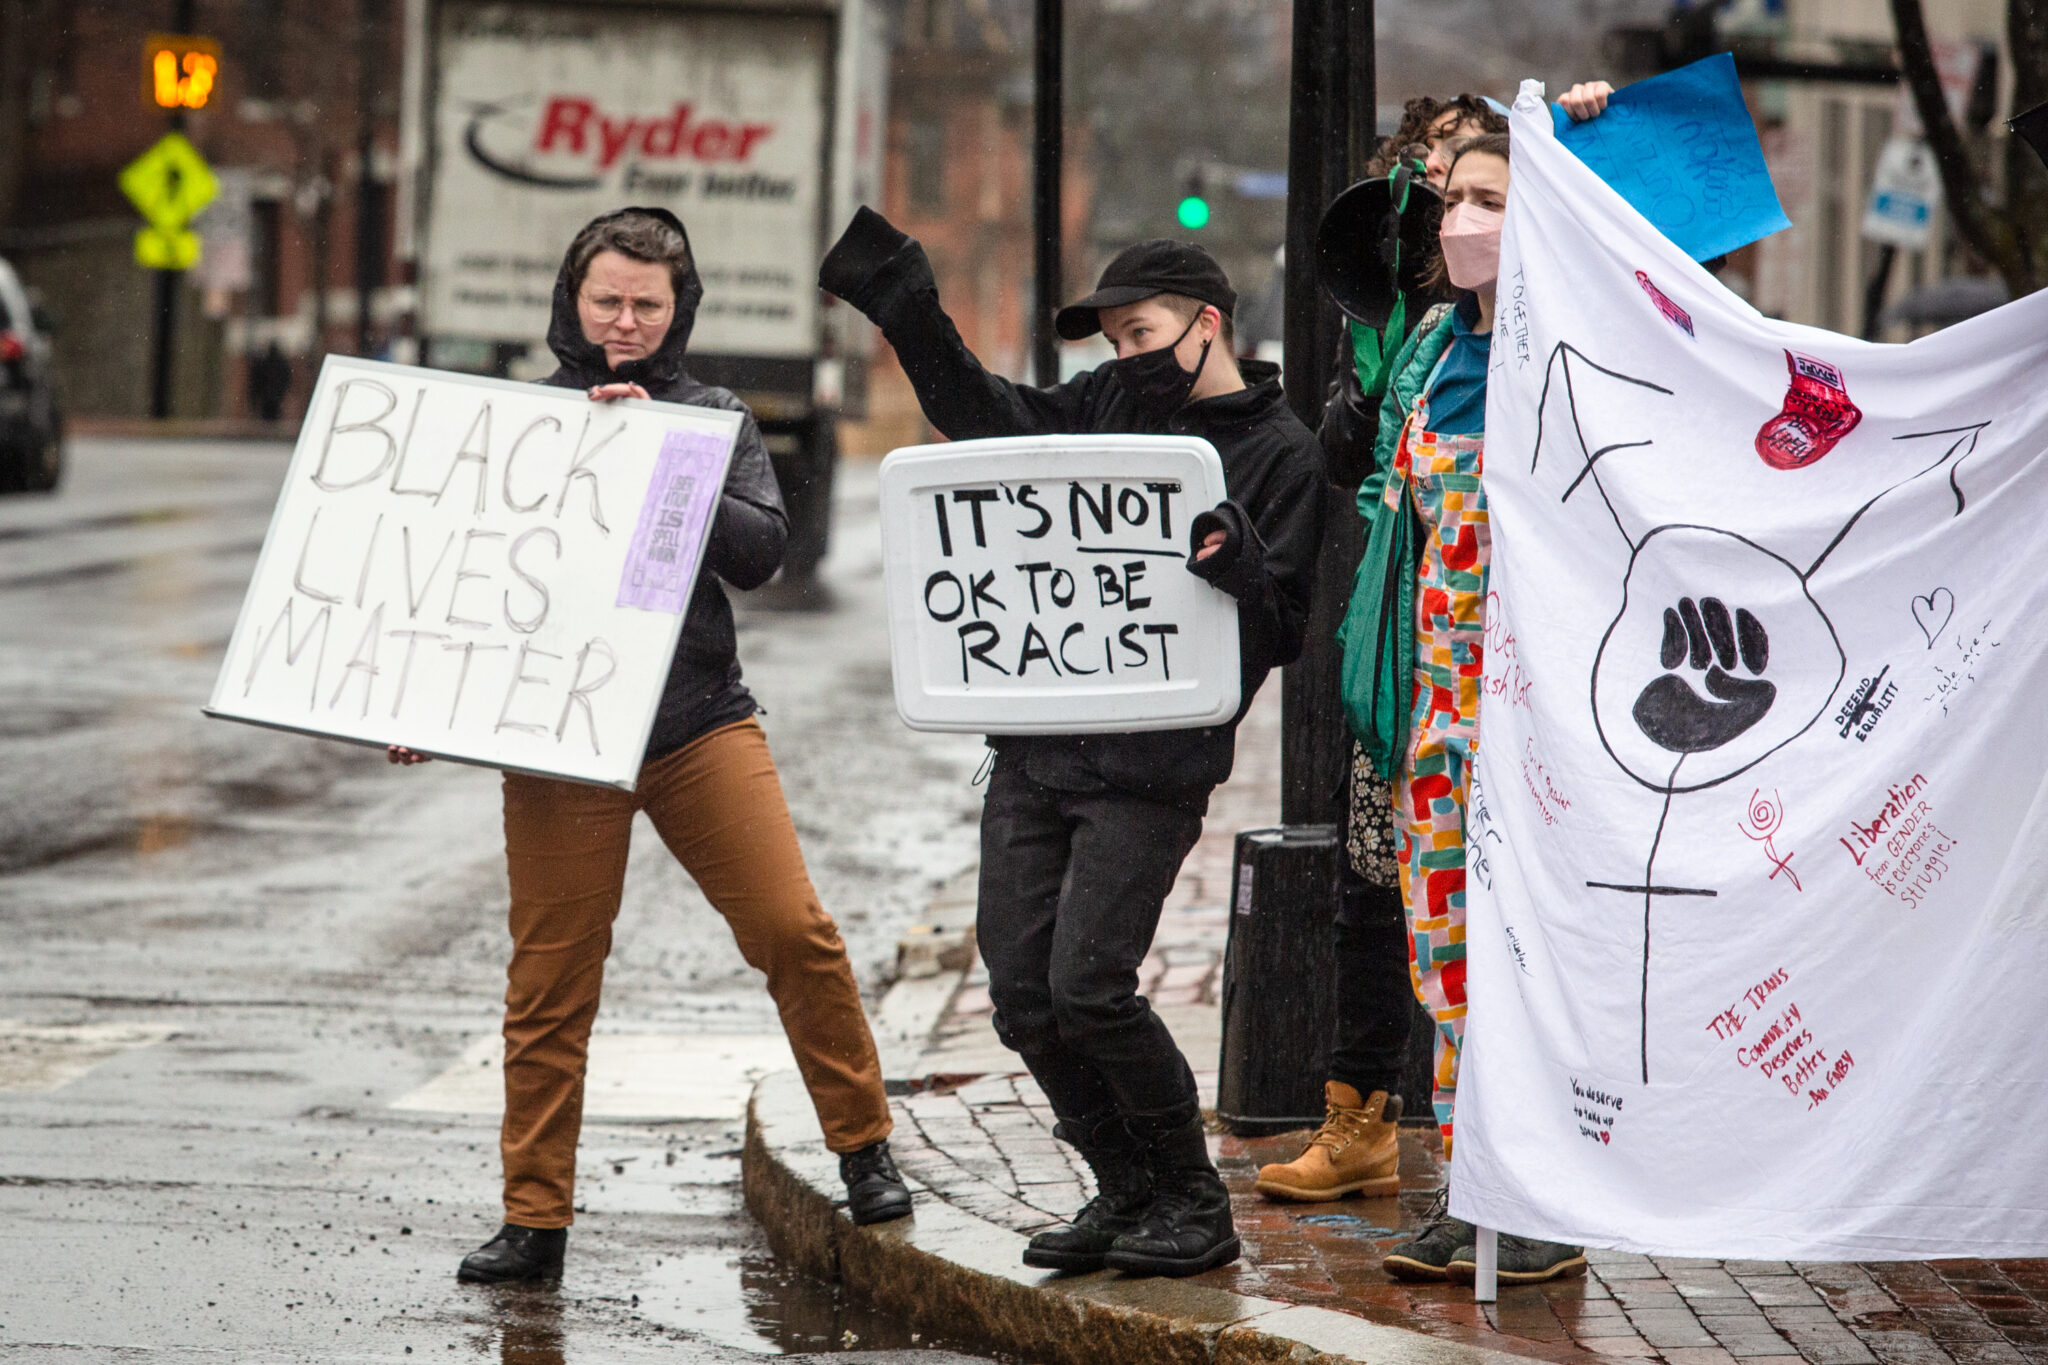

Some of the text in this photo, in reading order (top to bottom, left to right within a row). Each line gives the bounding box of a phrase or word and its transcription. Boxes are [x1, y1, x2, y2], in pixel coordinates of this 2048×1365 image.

[537, 95, 776, 173] Ryder
[1512, 262, 1529, 371] TOGETHER
[309, 377, 628, 535] BLACK
[657, 509, 684, 528] IS
[934, 481, 1182, 557] IT'S NOT
[293, 506, 563, 635] LIVES
[924, 560, 1152, 623] OK TO BE
[243, 596, 618, 756] MATTER
[957, 620, 1179, 685] RACIST
[1835, 677, 1871, 726] DEFEND
[1855, 680, 1899, 743] EQUALITY
[1839, 773, 1928, 866] Liberation
[1865, 800, 1933, 885] from GENDER
[1880, 822, 1937, 895] is everyone's
[1705, 967, 1789, 1041] THE TRANS
[1570, 1076, 1623, 1111] You deserve
[1781, 1048, 1827, 1096] Better
[1574, 1102, 1614, 1130] to take up
